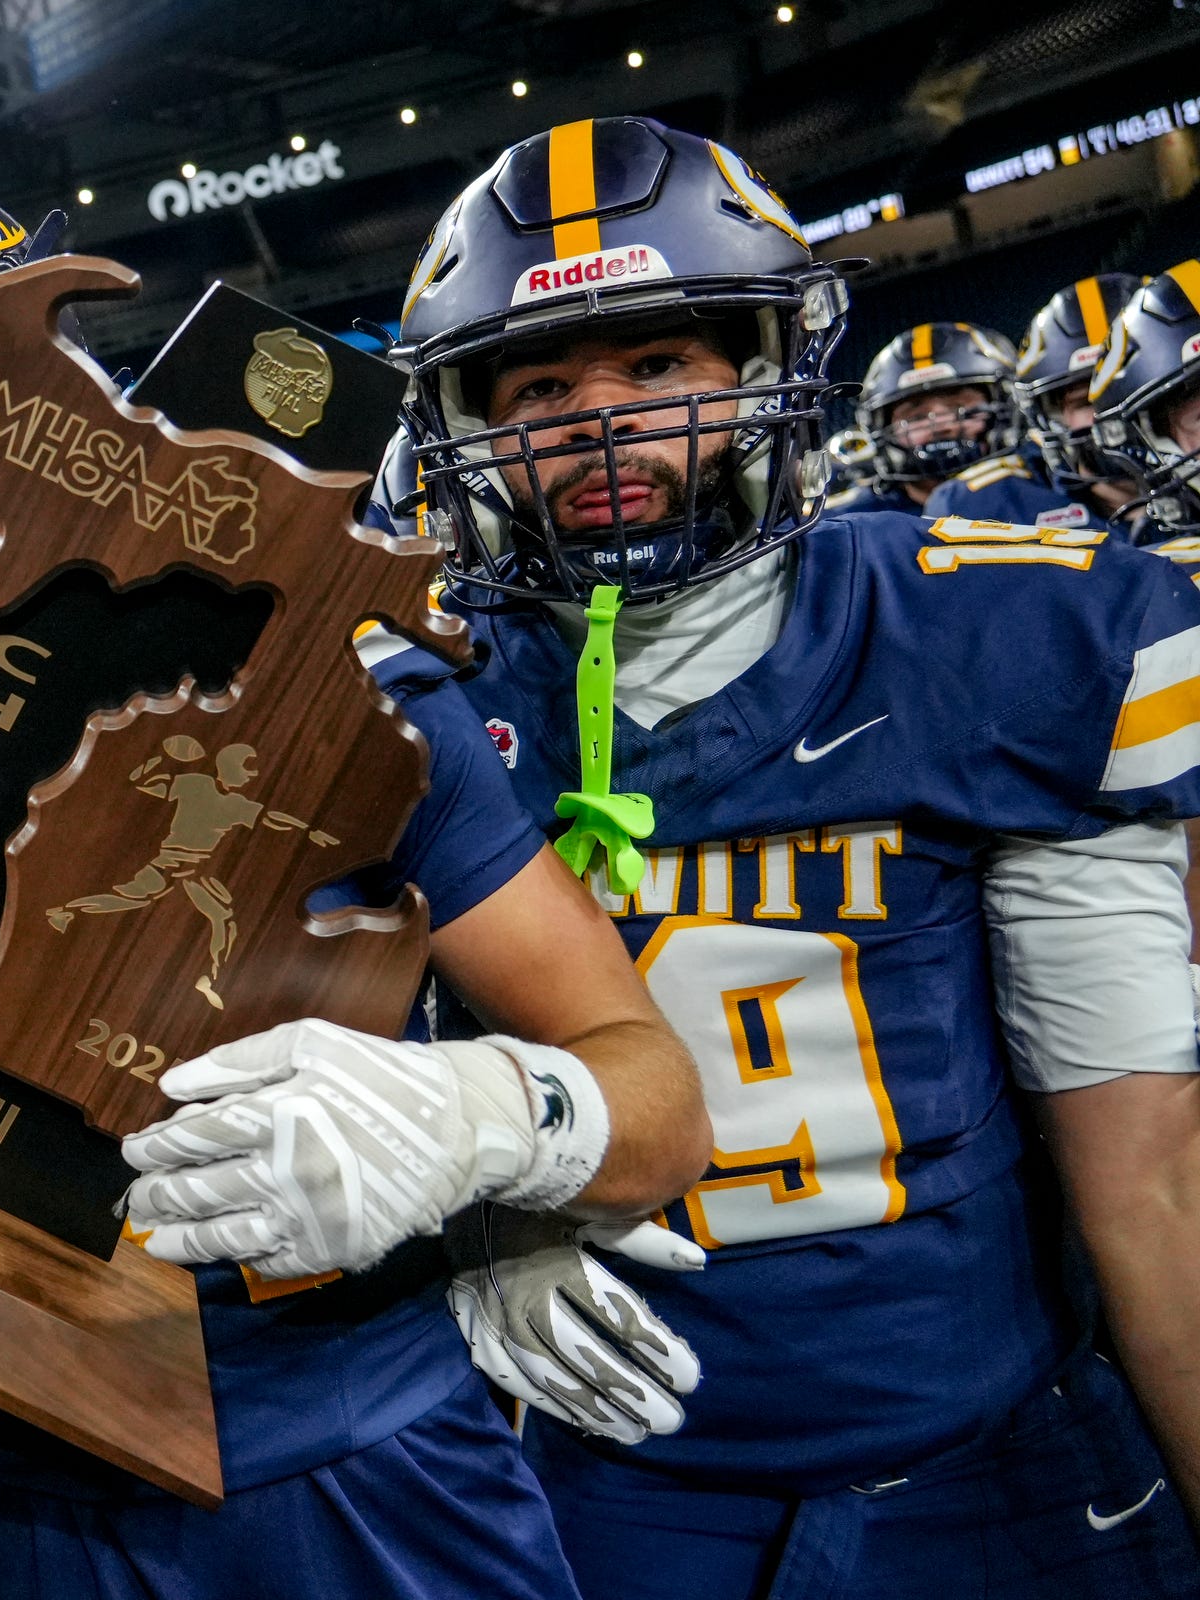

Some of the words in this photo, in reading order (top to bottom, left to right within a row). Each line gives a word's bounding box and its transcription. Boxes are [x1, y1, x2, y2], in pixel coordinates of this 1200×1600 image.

[188, 139, 345, 213] Rocket
[529, 249, 650, 295] Riddell
[584, 821, 902, 920] WITT
[74, 1018, 186, 1085] 202
[634, 915, 906, 1249] 9
